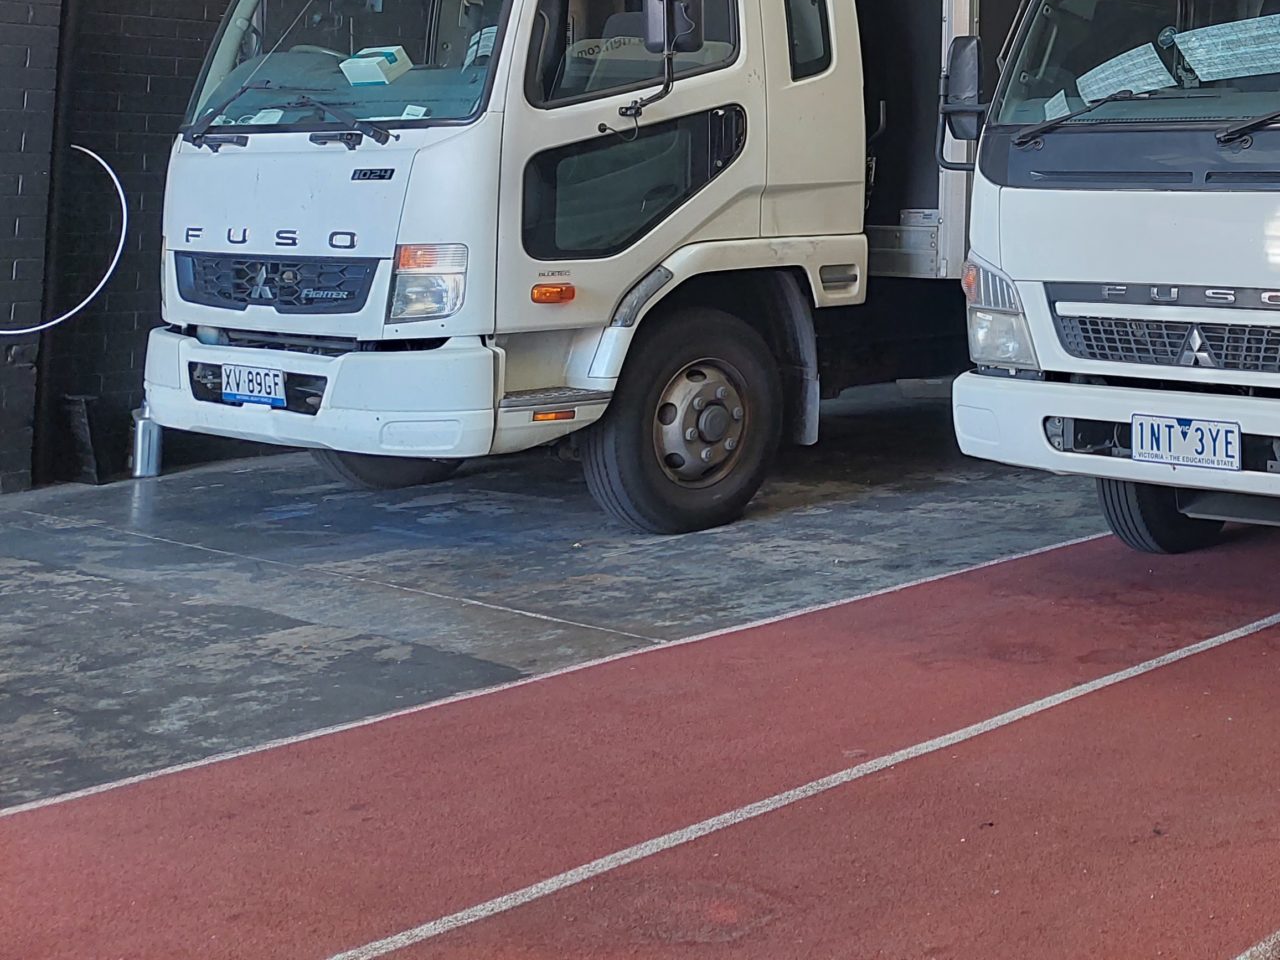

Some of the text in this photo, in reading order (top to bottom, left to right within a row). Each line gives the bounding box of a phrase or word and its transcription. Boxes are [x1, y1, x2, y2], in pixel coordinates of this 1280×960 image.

[354, 169, 393, 180] 1024
[185, 227, 359, 250] FUSO
[1194, 426, 1236, 459] 3YE
[1137, 451, 1164, 460] VICTORIA
[1182, 456, 1215, 466] EDUCATION
